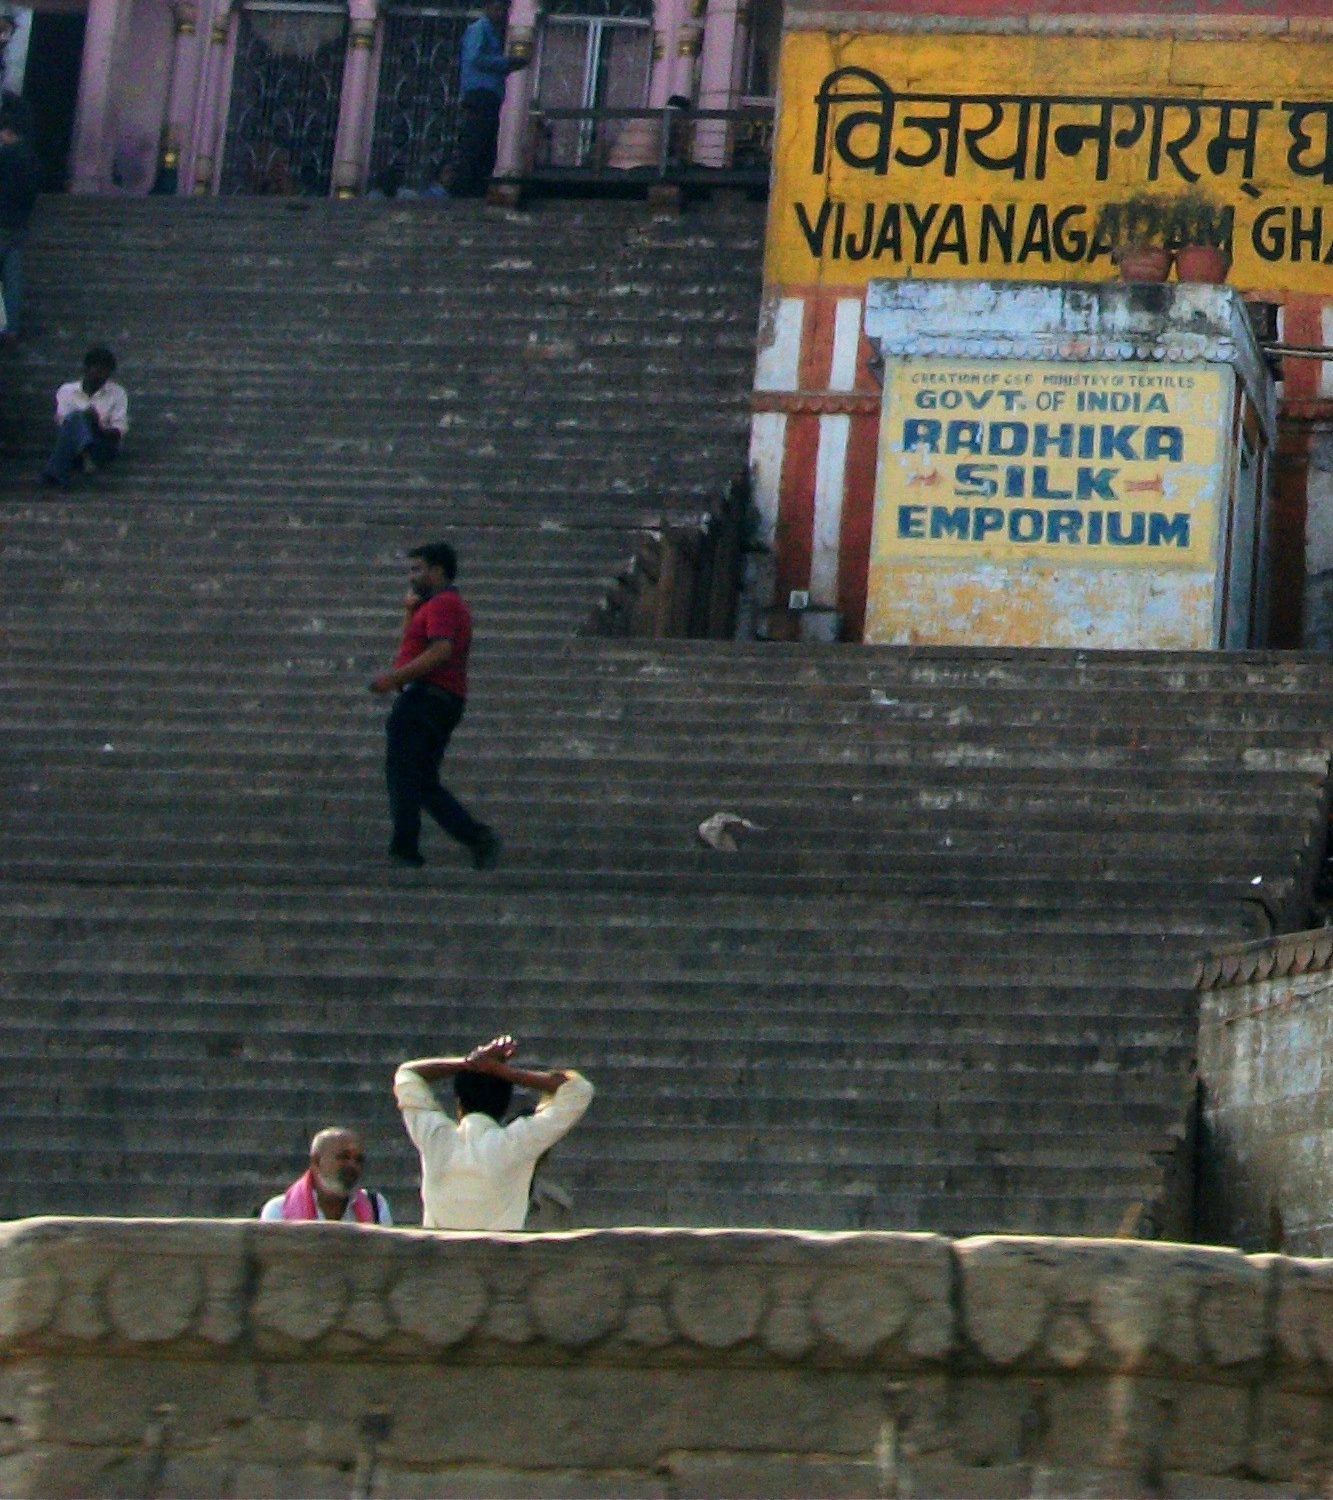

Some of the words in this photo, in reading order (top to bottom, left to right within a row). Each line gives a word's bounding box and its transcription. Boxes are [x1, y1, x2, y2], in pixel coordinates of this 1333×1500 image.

[812, 65, 1274, 198] विजयानगरम्
[793, 201, 1235, 268] VIJAYANAGAAM
[1036, 390, 1066, 412] OF
[1077, 390, 1170, 413] INDIA
[1128, 375, 1195, 389] TEXTILES
[902, 418, 1185, 463] RADHIKA
[953, 463, 1120, 501] SILK
[897, 505, 1191, 548] EMPORIUM
